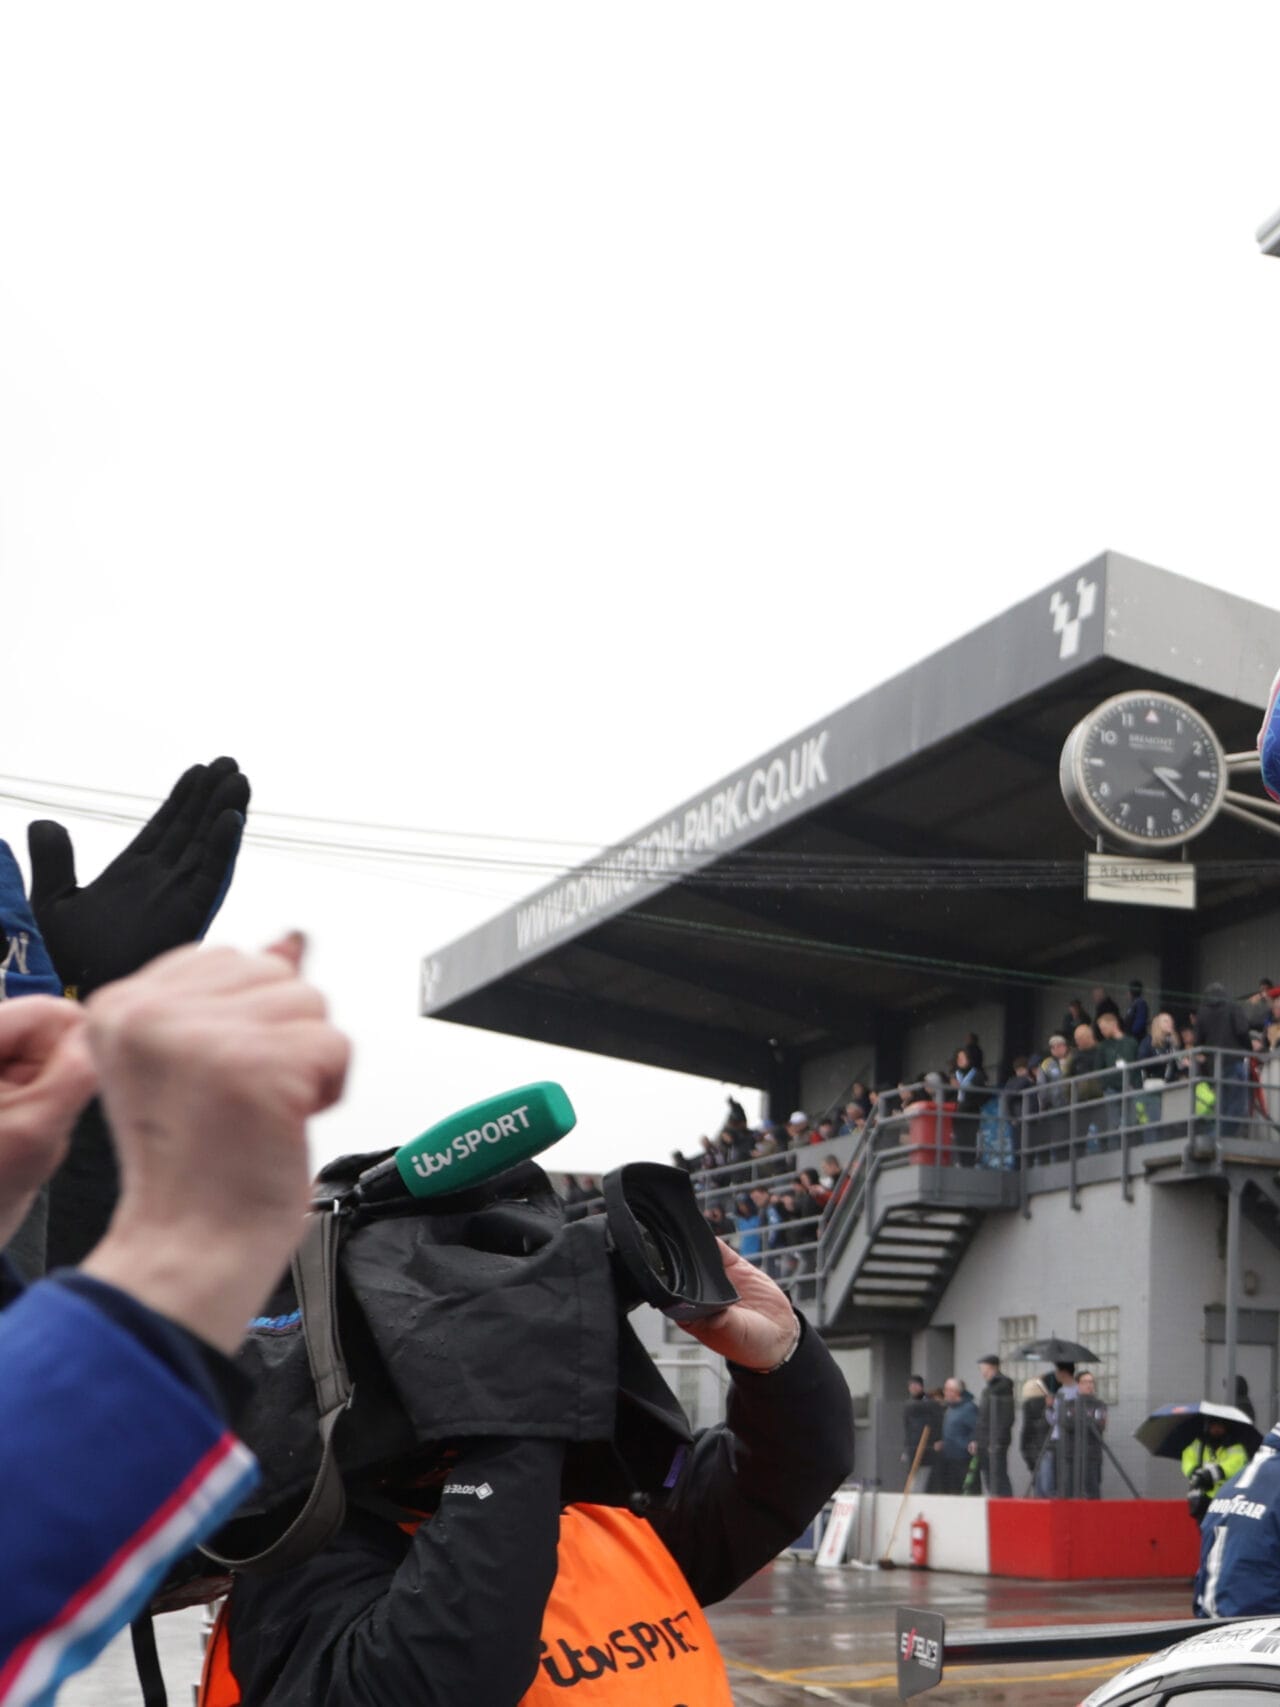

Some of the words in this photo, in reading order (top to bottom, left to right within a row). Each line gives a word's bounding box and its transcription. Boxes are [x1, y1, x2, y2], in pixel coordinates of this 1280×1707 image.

[1100, 730, 1117, 745] 10
[1192, 741, 1202, 756] 2
[411, 1148, 453, 1178] itv
[452, 1105, 530, 1159] SPORT
[540, 1638, 618, 1687] itv
